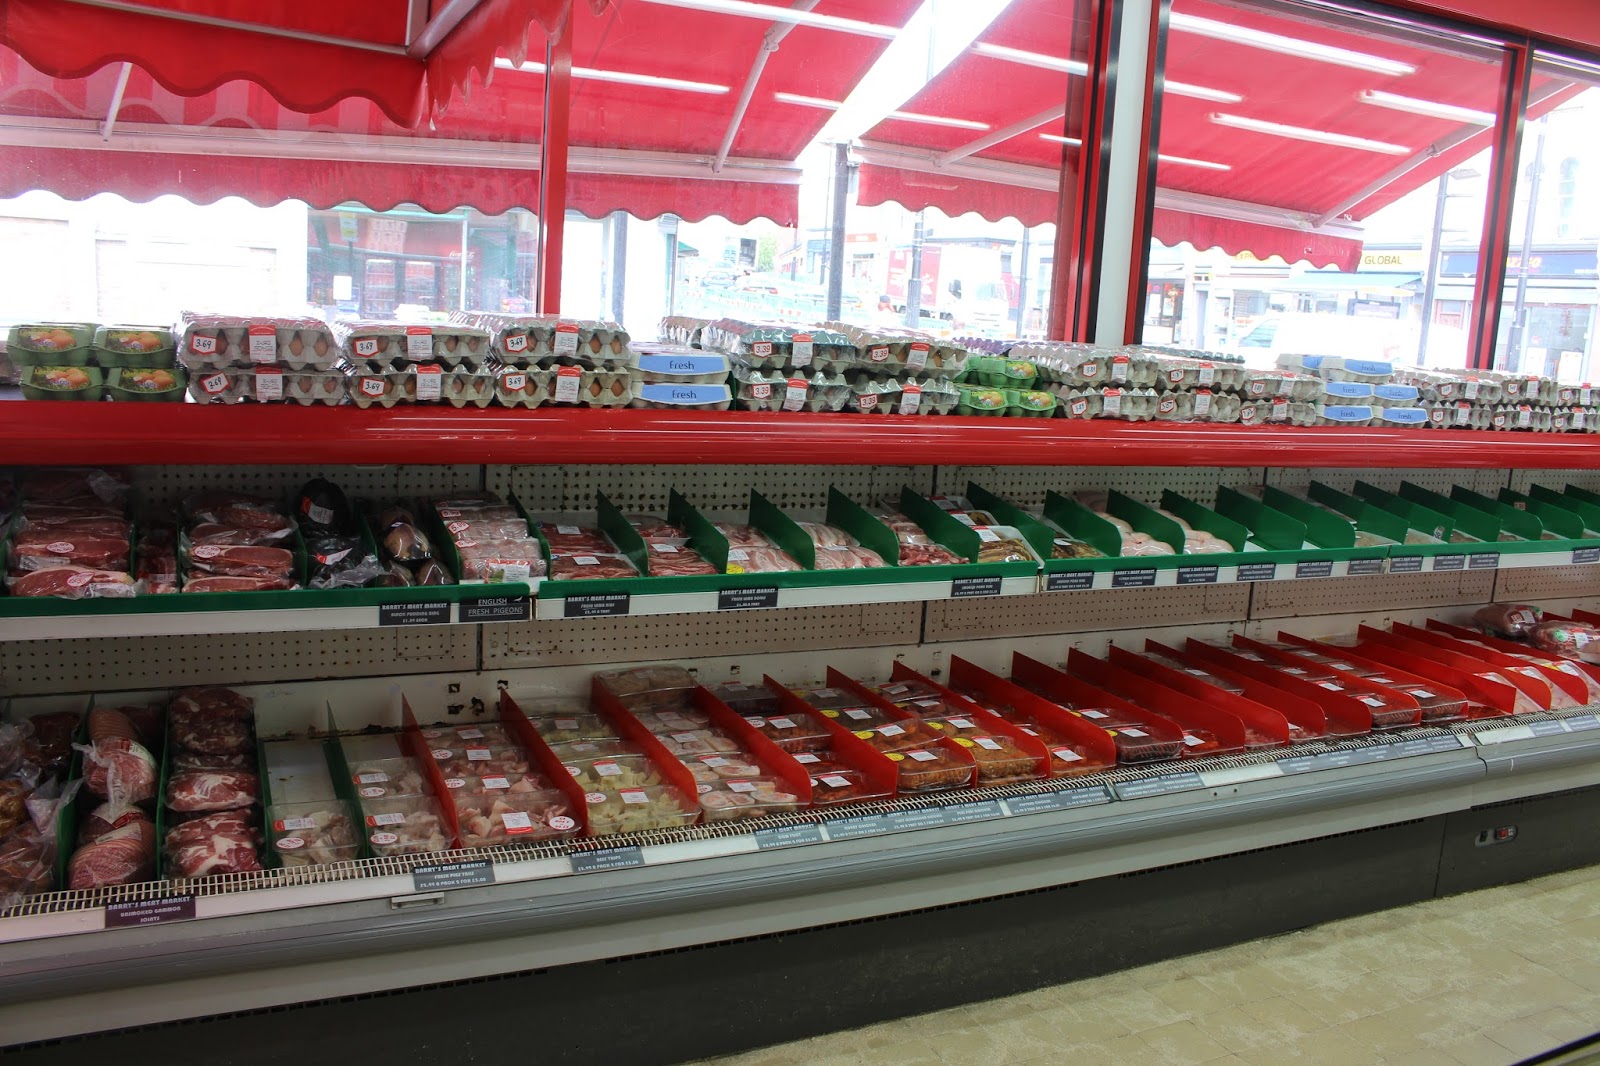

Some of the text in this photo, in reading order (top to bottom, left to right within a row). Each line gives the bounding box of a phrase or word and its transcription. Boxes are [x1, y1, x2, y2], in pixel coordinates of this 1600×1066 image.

[1364, 256, 1402, 265] GLOBAL
[196, 338, 212, 349] 3.69
[360, 342, 373, 351] 3.69
[510, 337, 523, 348] 3.69
[756, 345, 770, 353] 3.39
[874, 349, 888, 357] 3.39
[366, 382, 380, 390] 3.69
[508, 377, 522, 386] 3.69
[756, 386, 768, 395] 3.39
[862, 396, 876, 405] 3.39
[108, 896, 191, 910] BARRY'S MEAT MARKET
[120, 909, 153, 917] UNSMOKED
